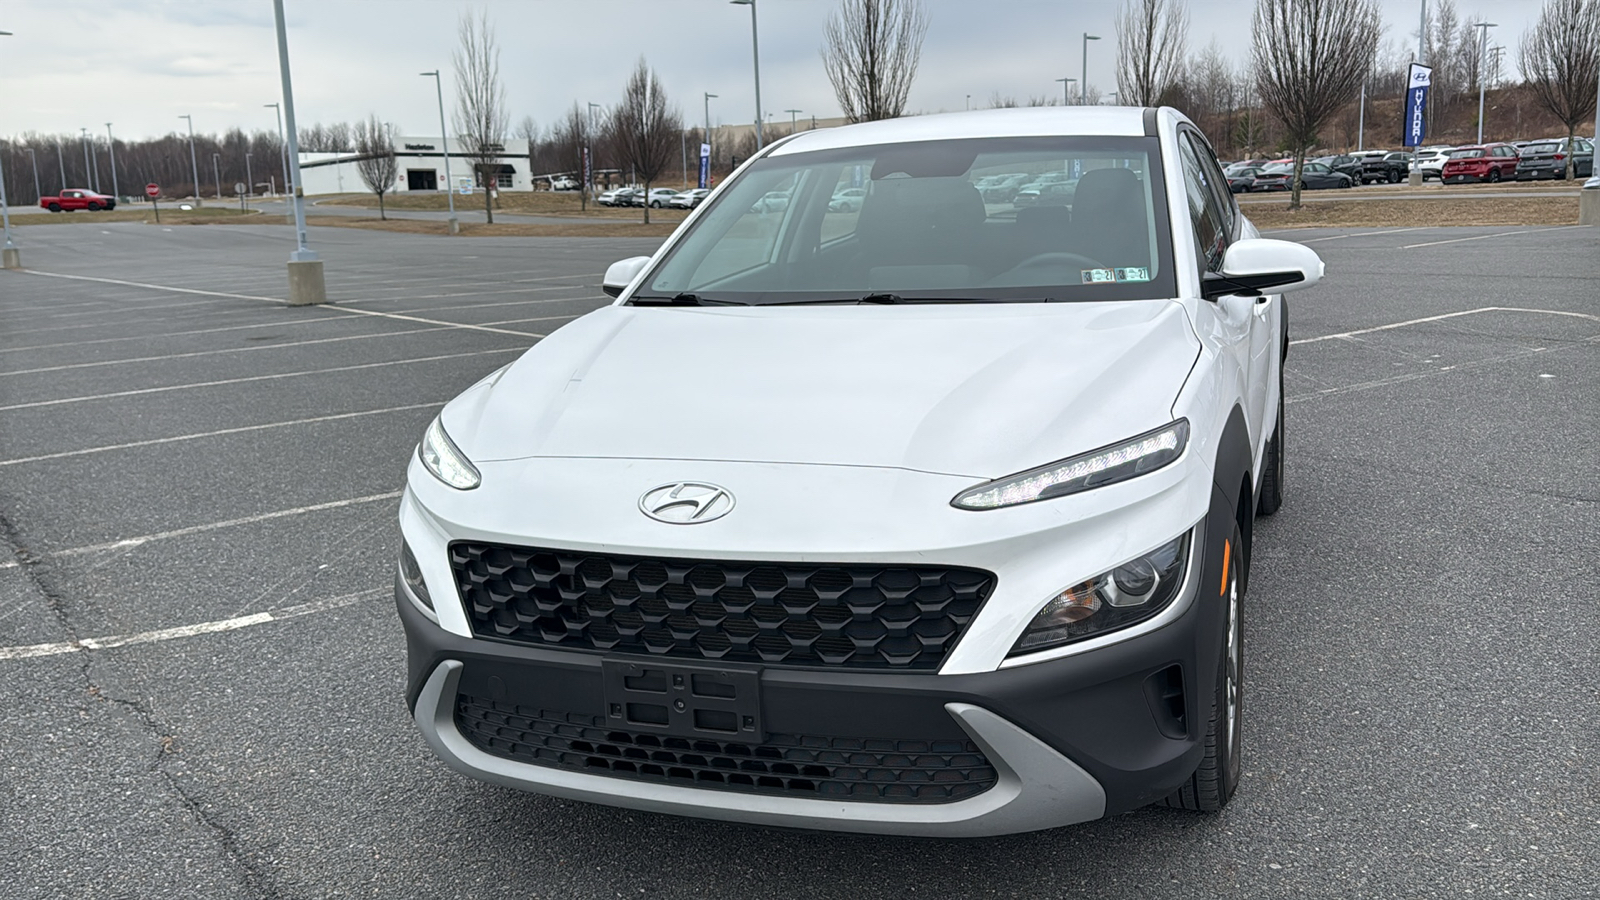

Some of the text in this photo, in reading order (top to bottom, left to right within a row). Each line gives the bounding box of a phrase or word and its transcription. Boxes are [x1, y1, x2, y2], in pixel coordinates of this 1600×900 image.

[1412, 90, 1423, 144] HYUNDAI
[1104, 270, 1113, 280] 27
[1138, 268, 1147, 279] 27
